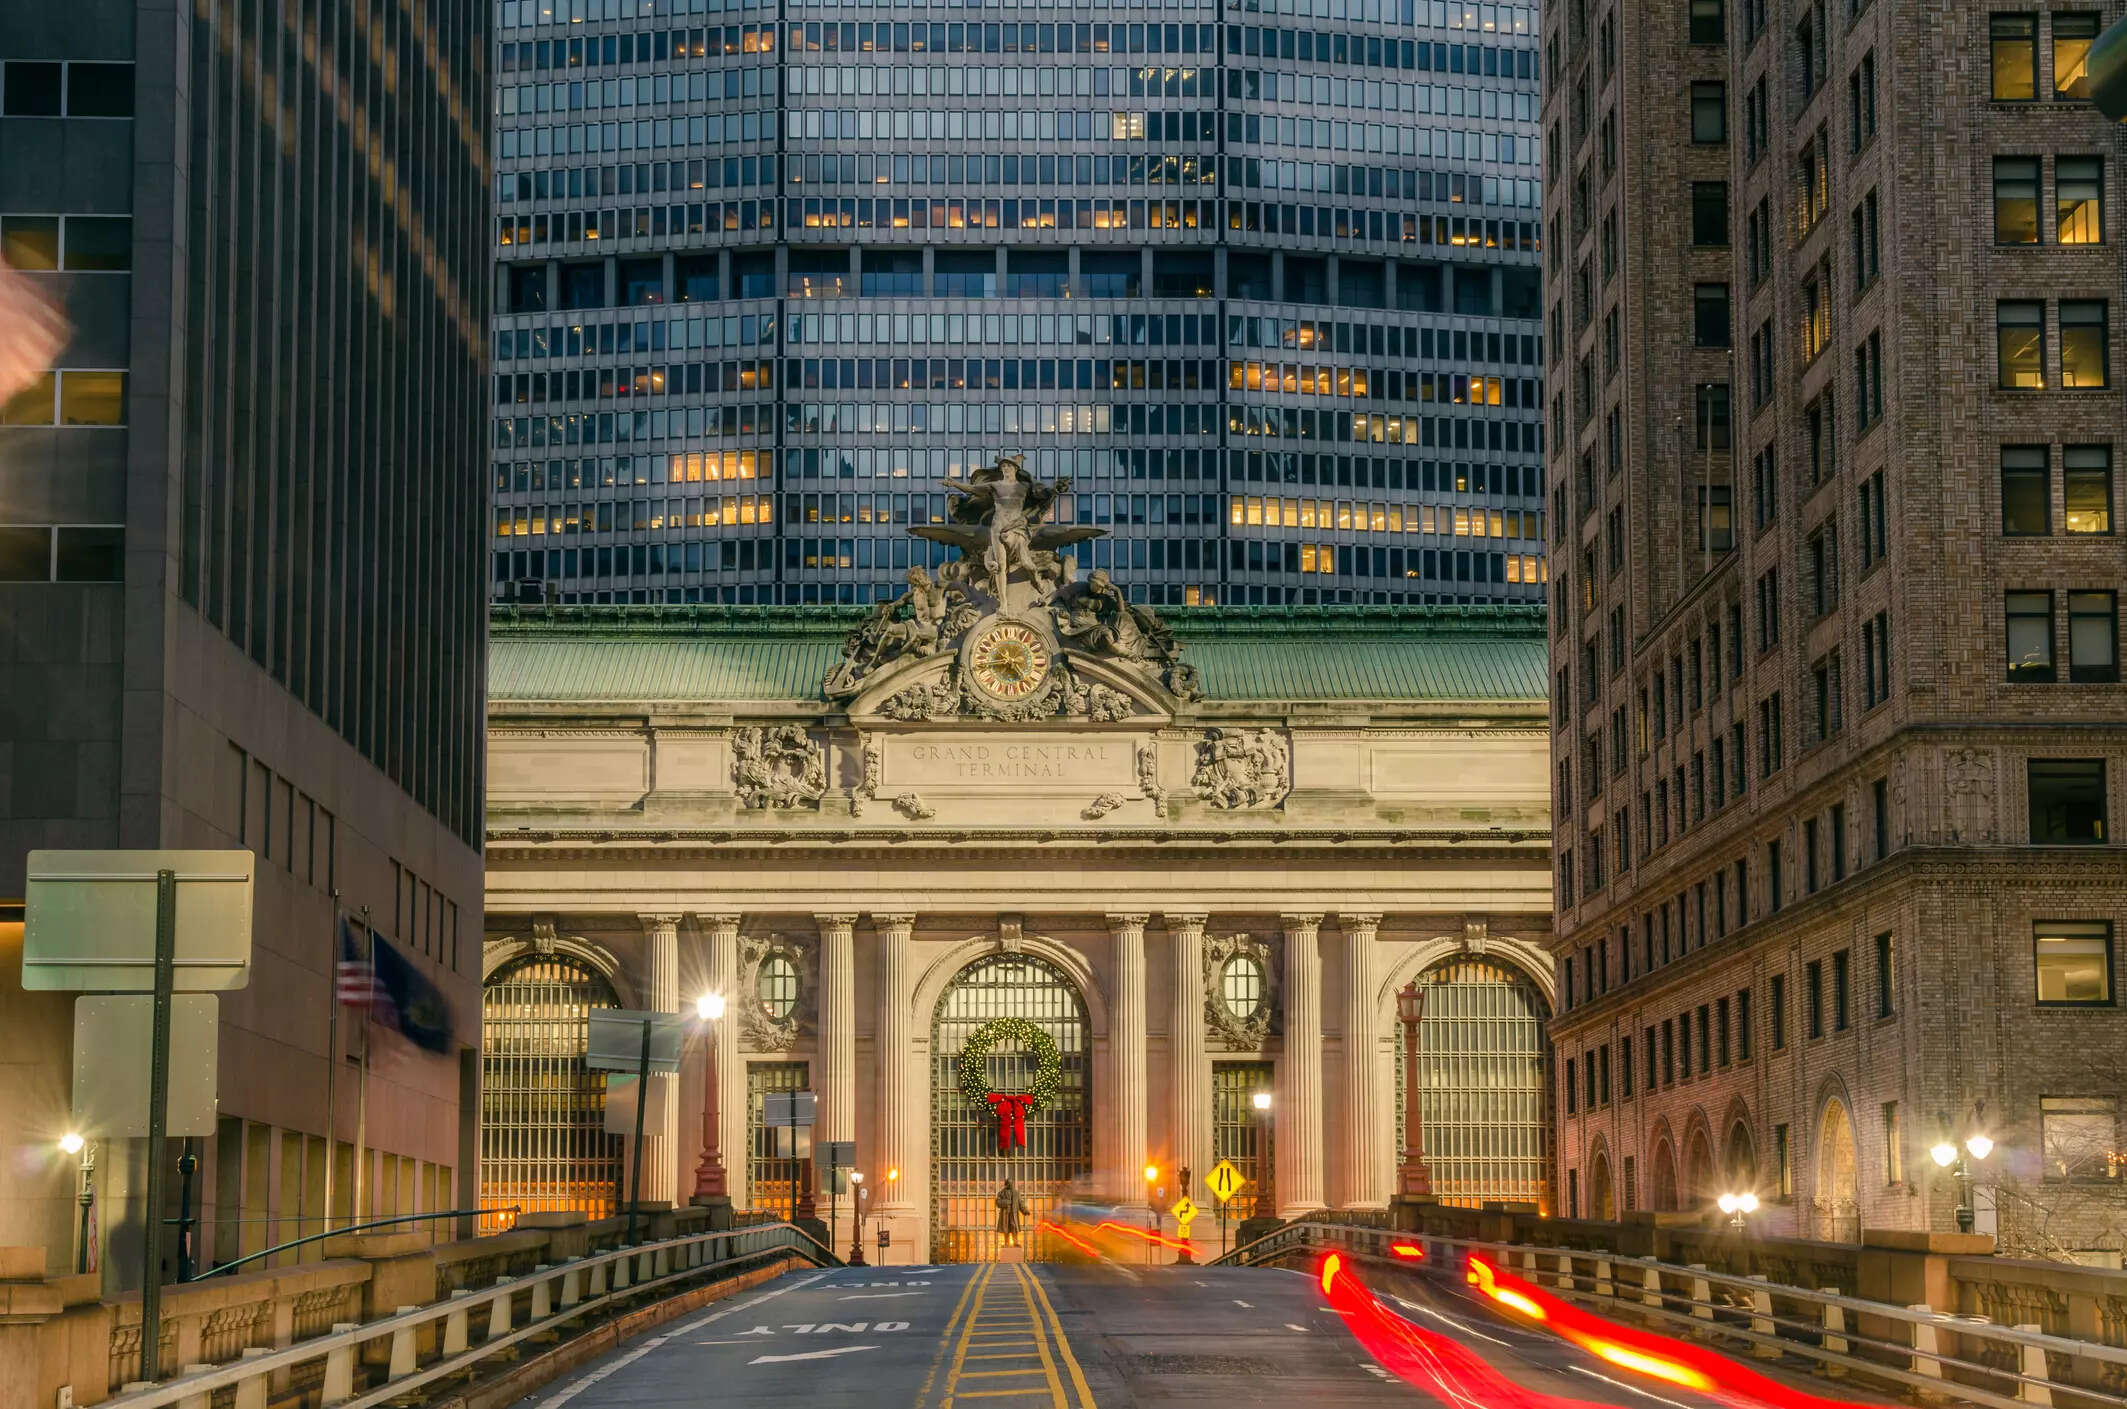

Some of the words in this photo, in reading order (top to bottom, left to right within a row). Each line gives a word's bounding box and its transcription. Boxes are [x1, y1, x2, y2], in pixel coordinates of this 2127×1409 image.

[913, 746, 990, 760] GRAND
[1006, 746, 1110, 760] CENTRAL
[957, 763, 1066, 777] TERMINAL
[816, 1281, 932, 1290] ONLY
[733, 1321, 911, 1335] ONLY
